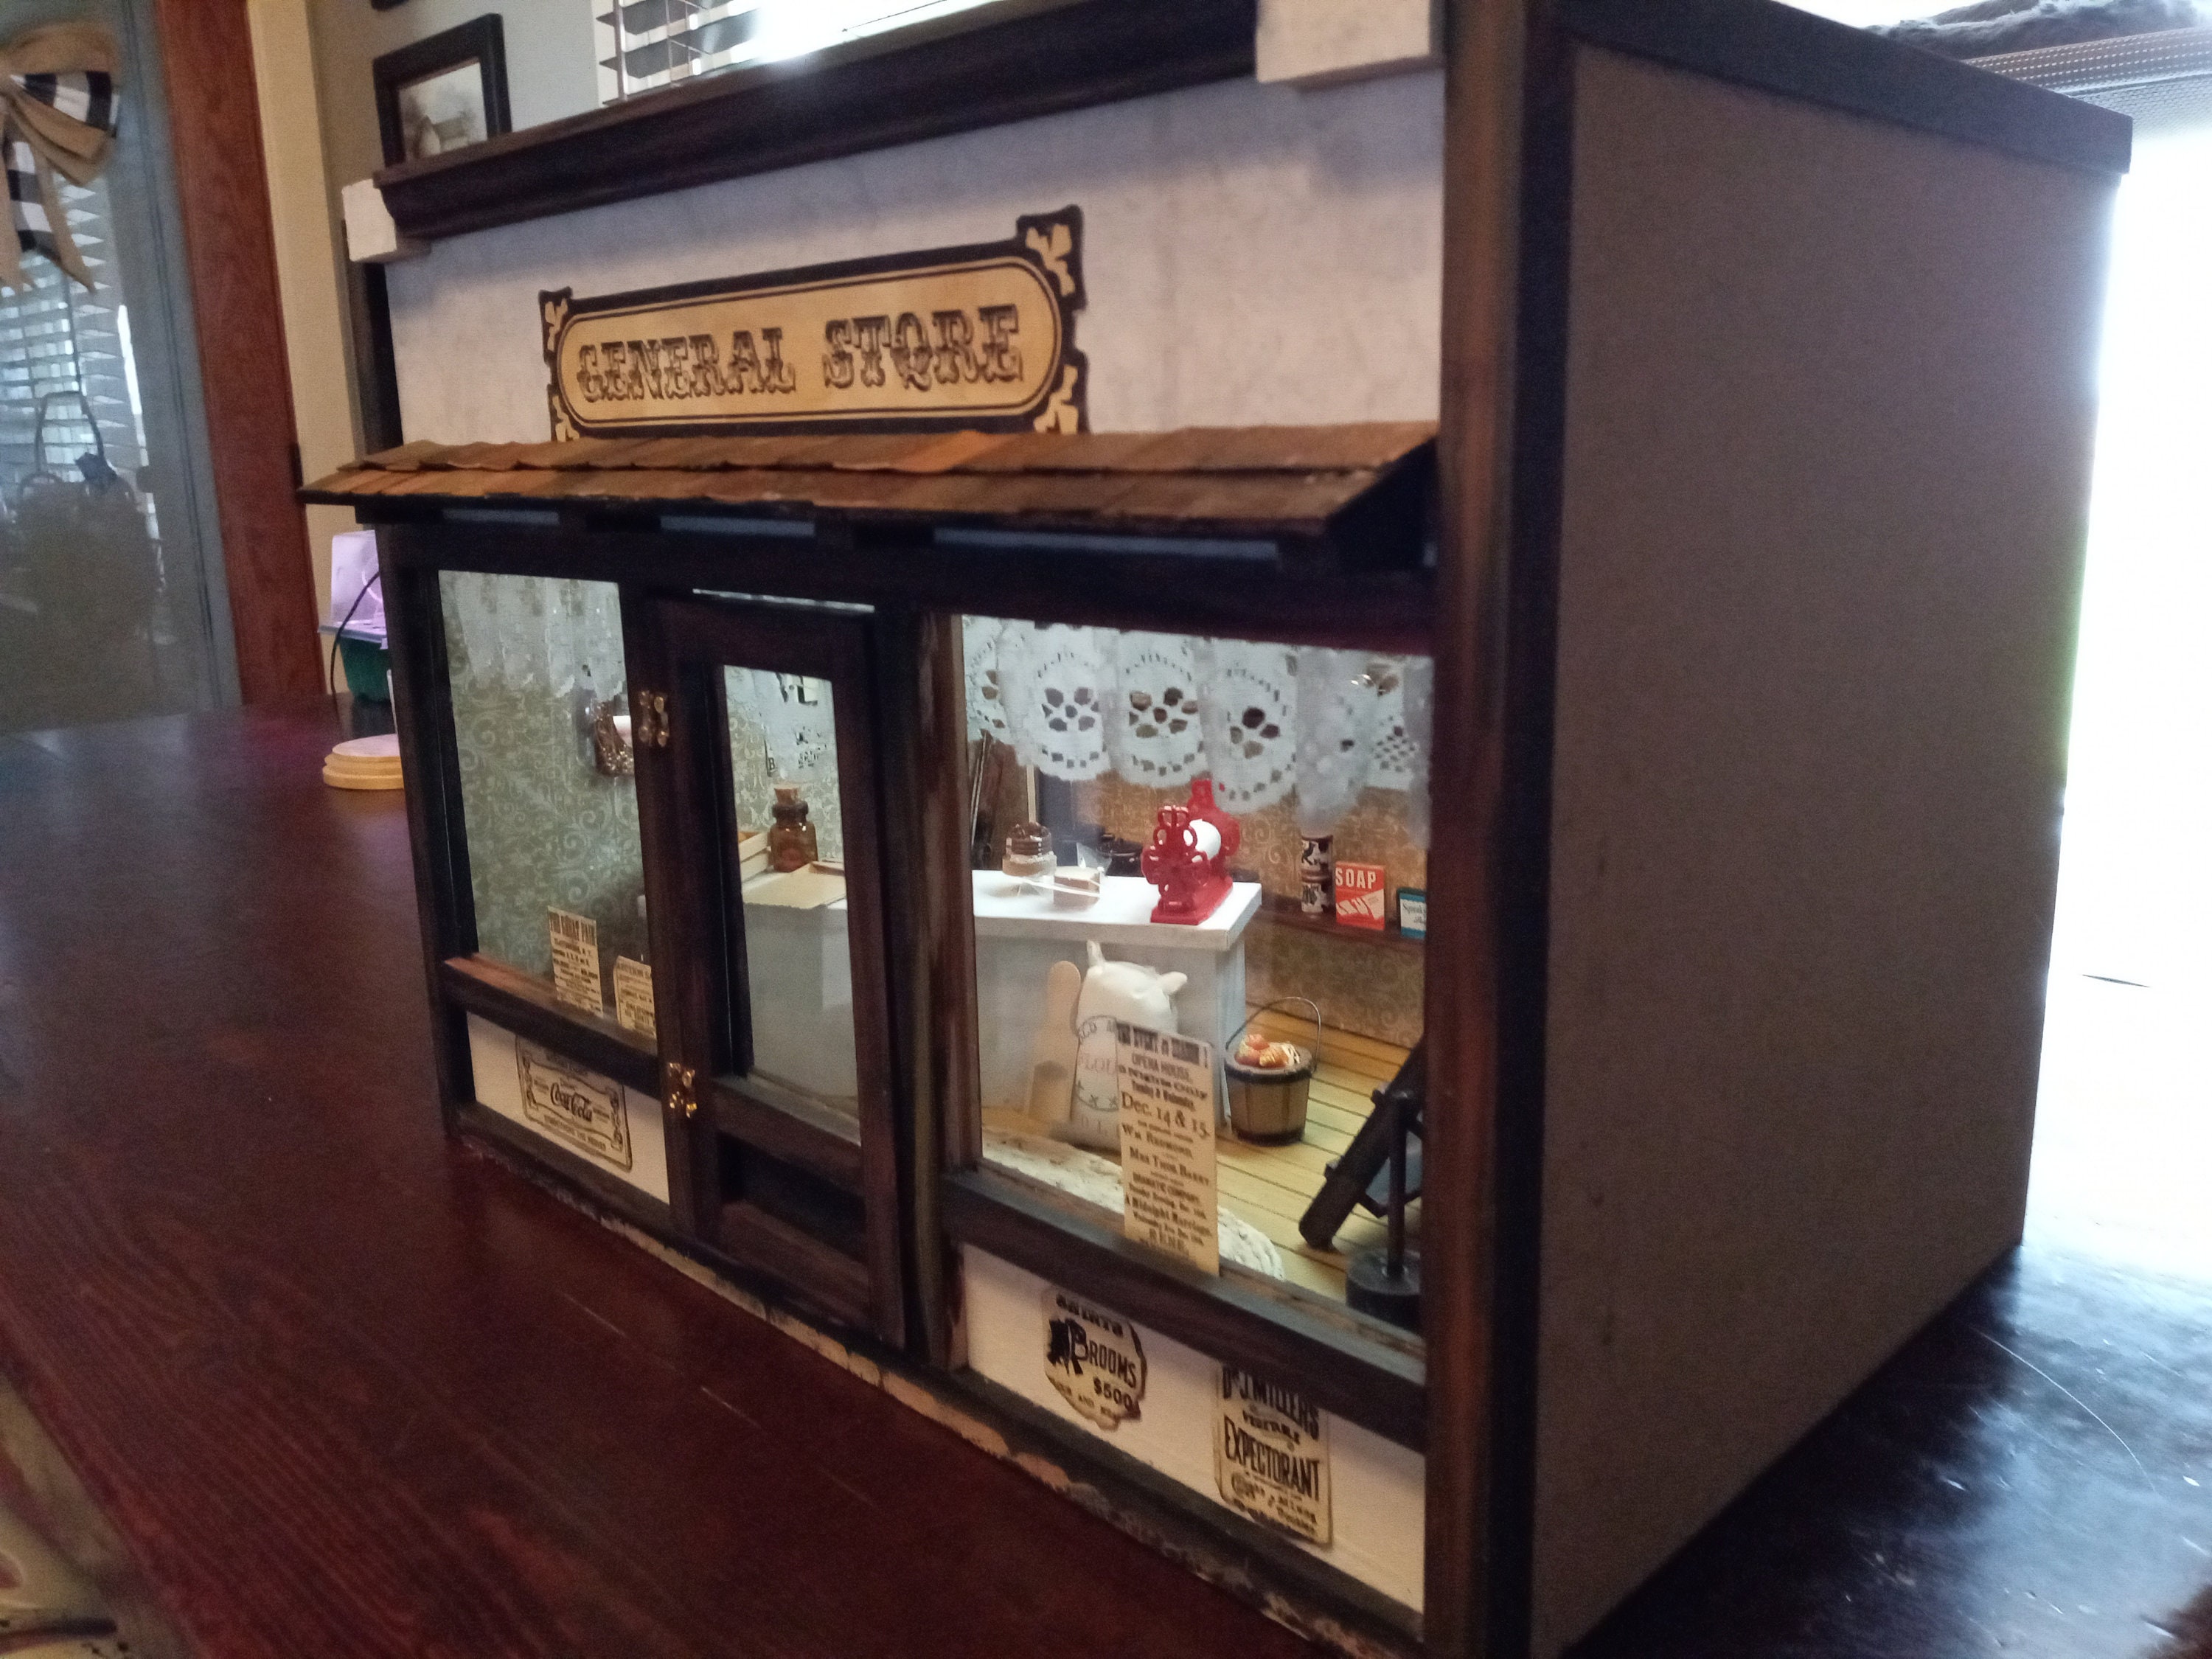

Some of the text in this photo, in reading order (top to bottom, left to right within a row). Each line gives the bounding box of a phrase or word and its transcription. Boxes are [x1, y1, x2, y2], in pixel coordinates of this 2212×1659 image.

[576, 303, 1024, 403] GENERAL STORE
[1335, 867, 1377, 889] SOAP
[1224, 1413, 1320, 1501] EXPECTORANT
